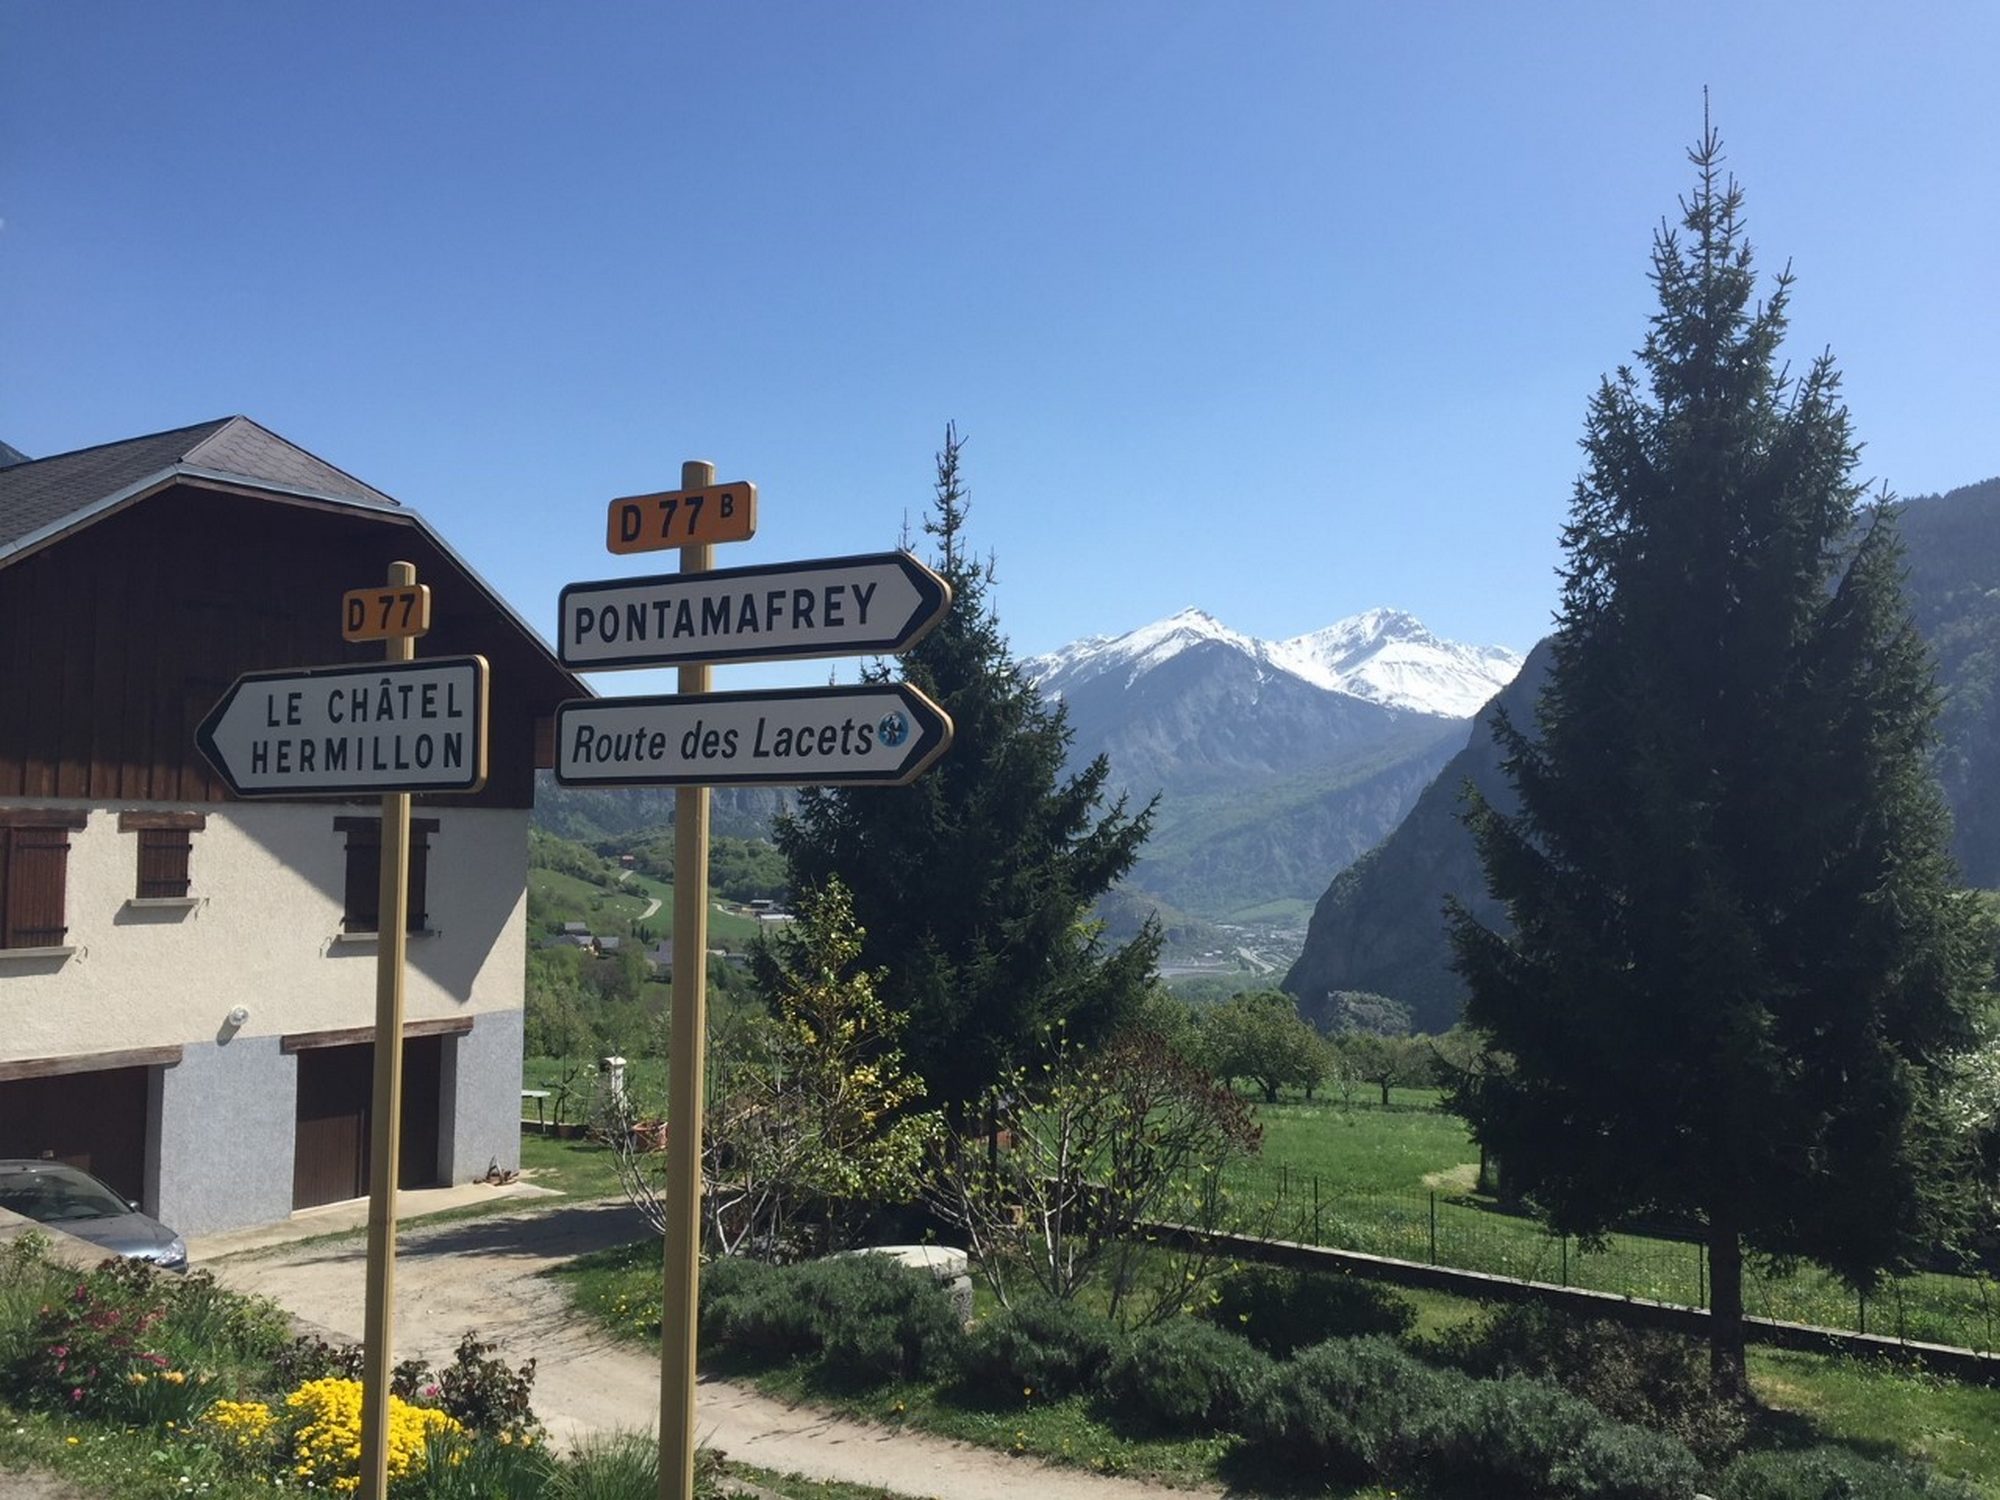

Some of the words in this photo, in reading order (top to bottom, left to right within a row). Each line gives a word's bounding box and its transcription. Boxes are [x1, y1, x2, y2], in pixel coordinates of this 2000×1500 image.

[620, 504, 642, 543] D
[658, 496, 704, 538] 77
[720, 493, 734, 519] B
[347, 598, 365, 633] D
[378, 594, 416, 630] 77
[574, 582, 878, 645] PONTAMAFREY
[266, 692, 303, 728] LE
[327, 677, 463, 724] CHÂTEL
[251, 732, 463, 775] HERMILLON
[571, 724, 667, 764] Route
[680, 720, 739, 761] des
[752, 717, 875, 758] Lacets
